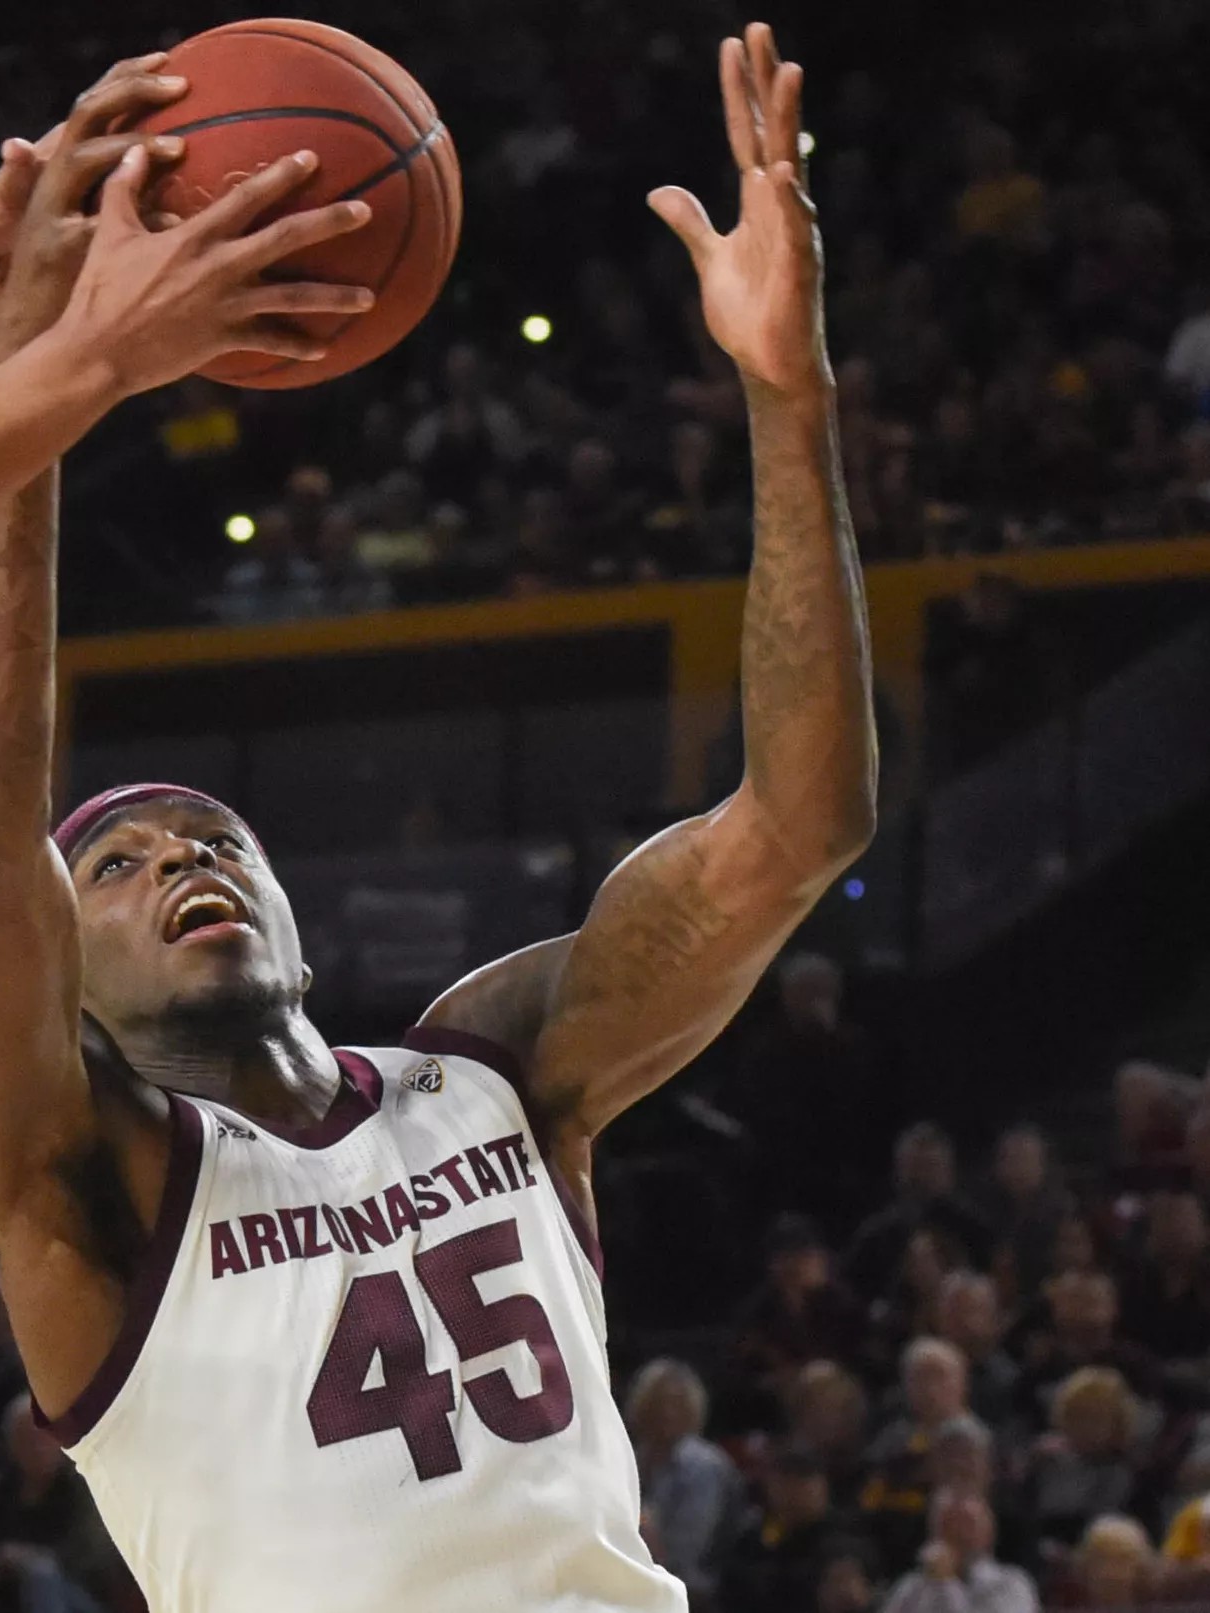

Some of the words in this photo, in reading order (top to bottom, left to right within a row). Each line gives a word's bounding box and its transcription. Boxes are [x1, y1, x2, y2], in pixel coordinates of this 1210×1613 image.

[209, 1184, 421, 1279] ARIZONA
[410, 1131, 537, 1220] STATE
[306, 1217, 574, 1482] 45
